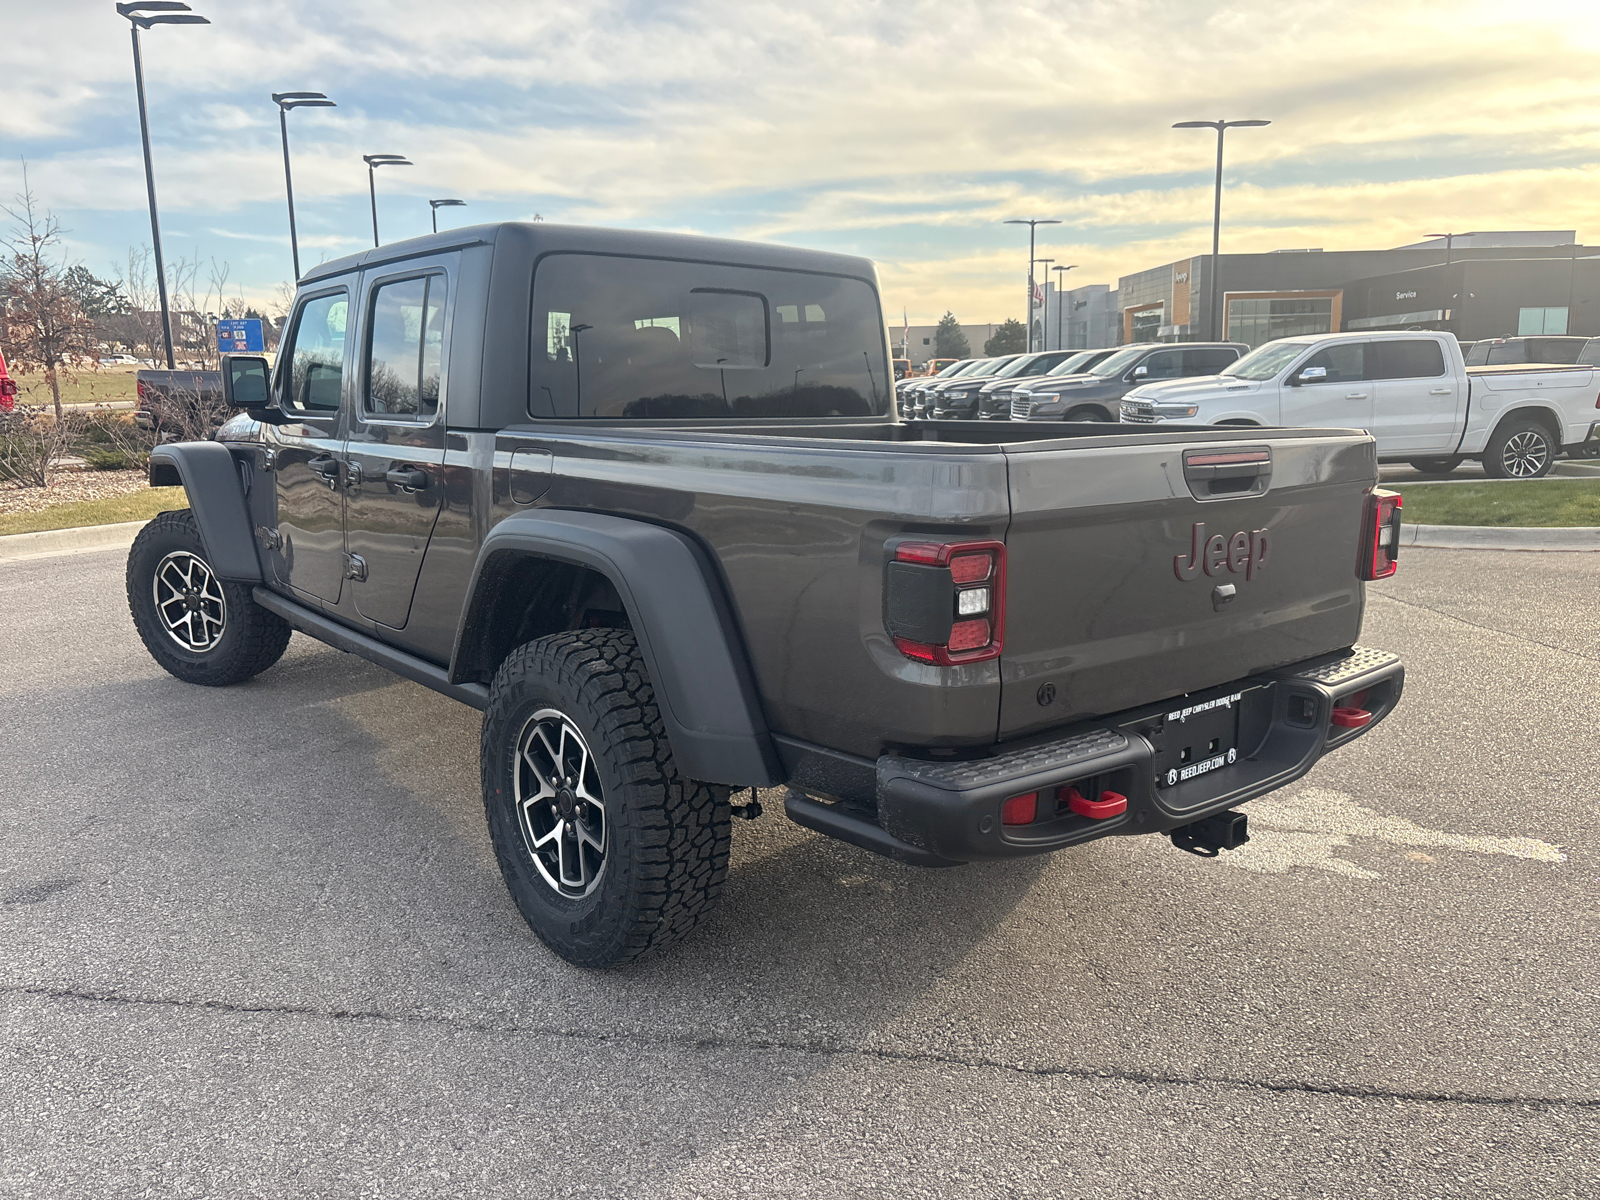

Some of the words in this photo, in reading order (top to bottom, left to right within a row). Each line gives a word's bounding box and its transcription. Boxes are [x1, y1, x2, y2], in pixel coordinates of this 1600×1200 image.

[1396, 291, 1417, 300] Service
[1174, 522, 1271, 582] Jeep
[1168, 710, 1181, 721] REED
[1181, 706, 1193, 717] JEEP
[1193, 700, 1216, 714] CHRYSLER
[1215, 695, 1231, 707] DODGE
[1230, 692, 1242, 703] RAM
[1180, 756, 1225, 781] REEDJEEP.COM
